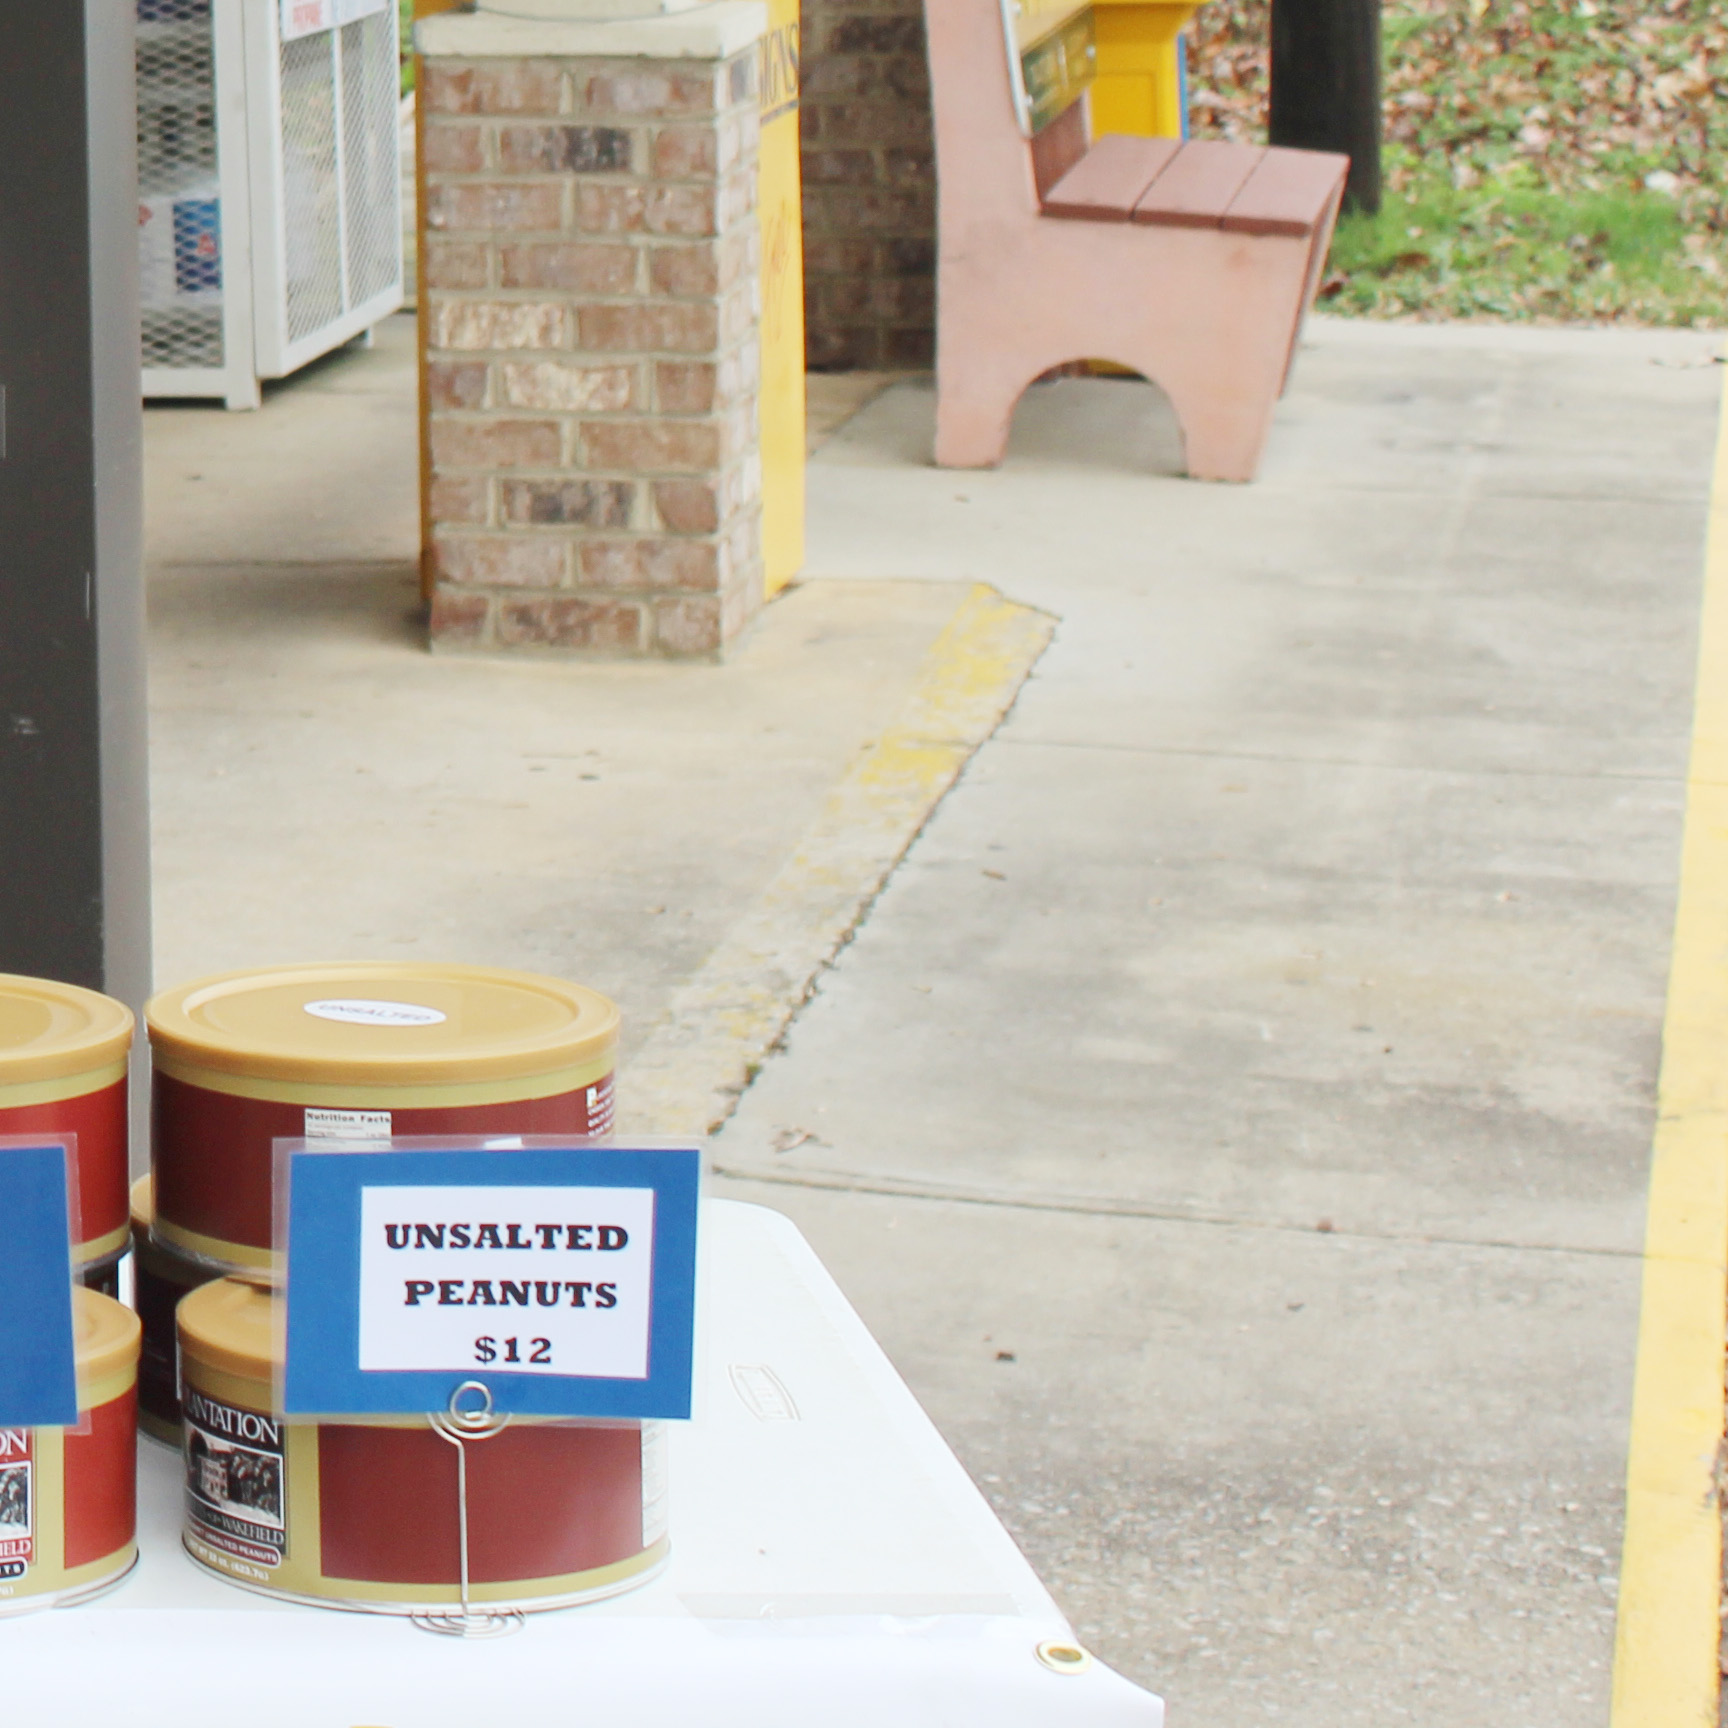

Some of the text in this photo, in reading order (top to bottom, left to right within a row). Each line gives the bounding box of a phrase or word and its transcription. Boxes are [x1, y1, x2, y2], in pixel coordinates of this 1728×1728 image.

[306, 1112, 392, 1123] Nutrition Facts
[384, 1223, 630, 1251] UNSALTED
[404, 1280, 618, 1309] PEANUTS
[475, 1335, 553, 1365] $12
[221, 1515, 285, 1545] WAKEFIELD
